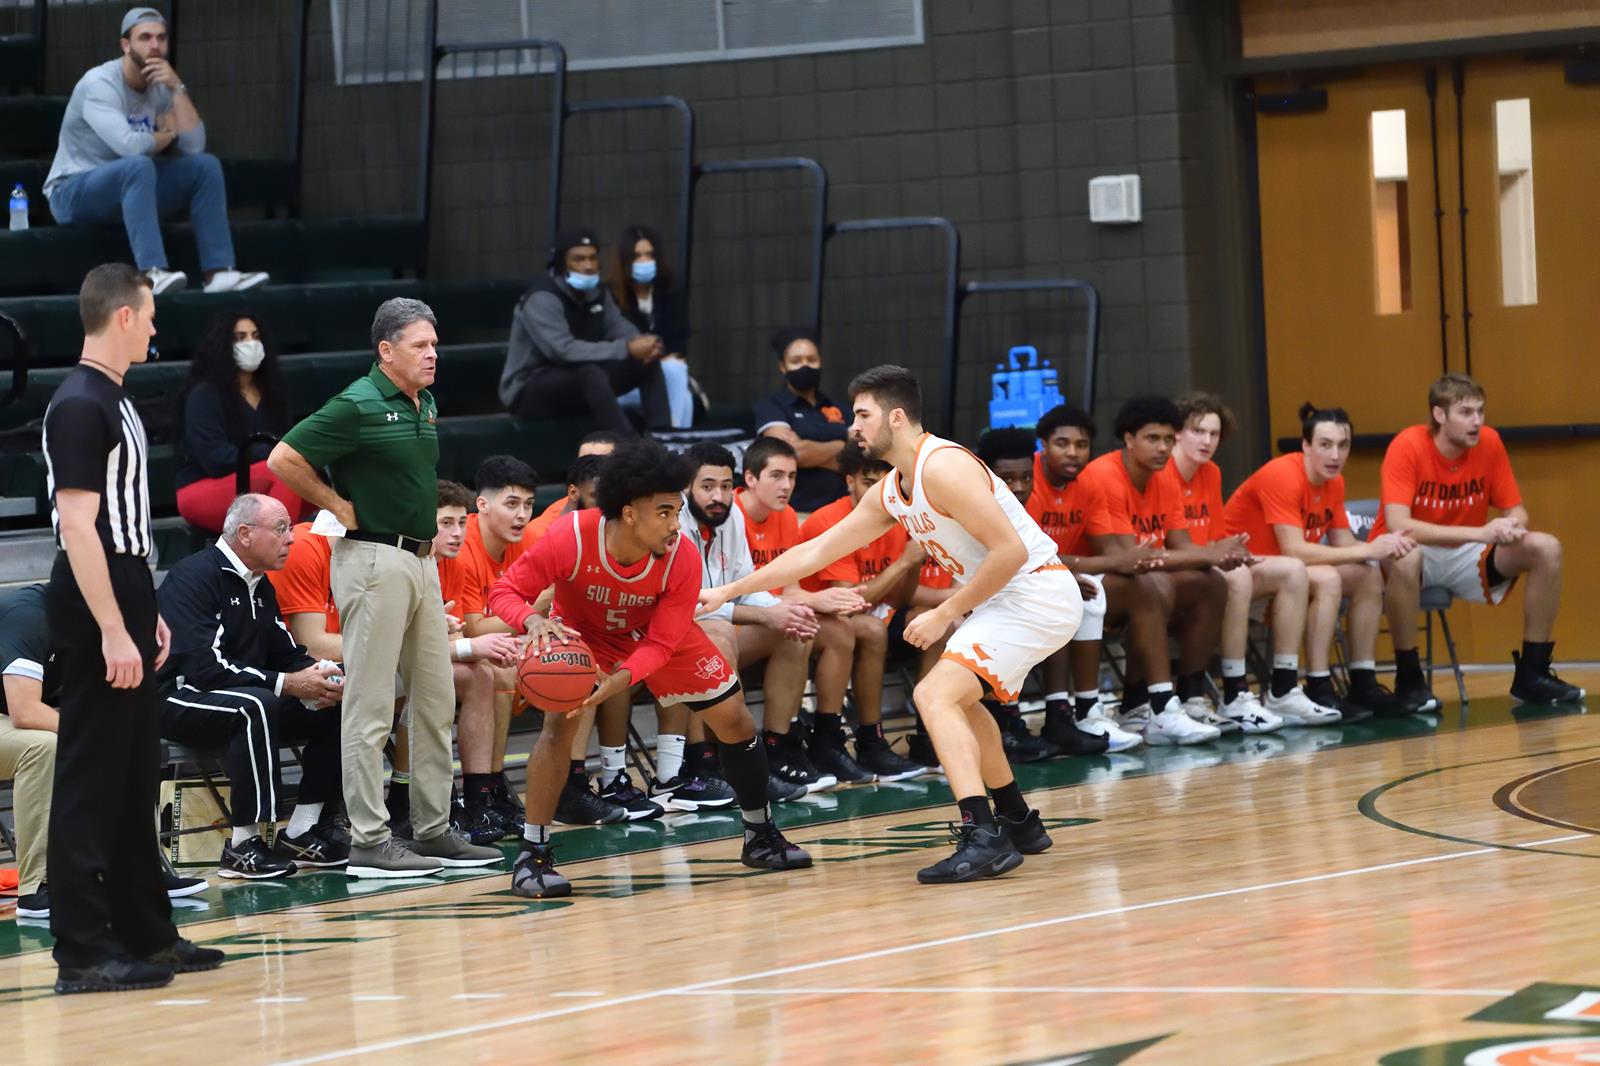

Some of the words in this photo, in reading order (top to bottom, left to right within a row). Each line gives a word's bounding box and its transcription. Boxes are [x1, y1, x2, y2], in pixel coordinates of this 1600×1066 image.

[586, 584, 612, 605] SUL
[617, 590, 655, 608] ROSS
[605, 608, 627, 631] 5
[541, 651, 593, 668] Wilson
